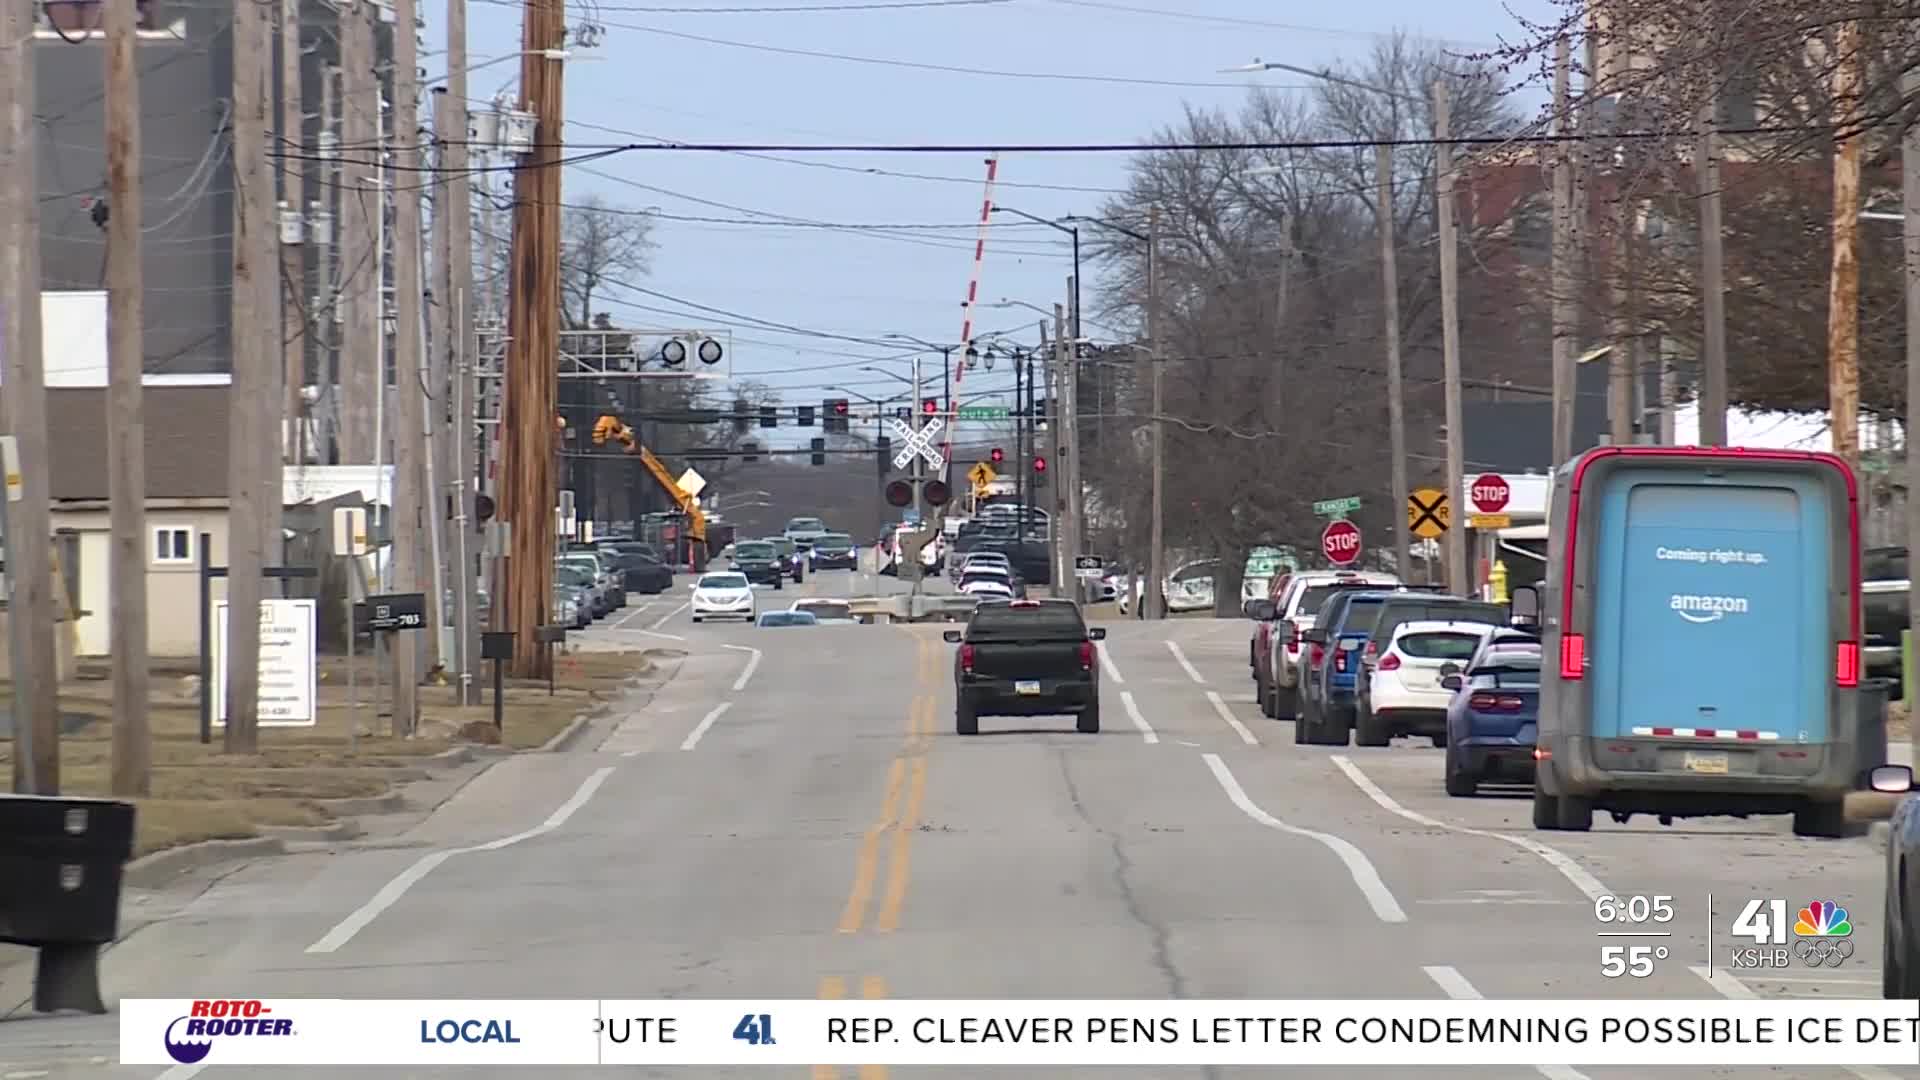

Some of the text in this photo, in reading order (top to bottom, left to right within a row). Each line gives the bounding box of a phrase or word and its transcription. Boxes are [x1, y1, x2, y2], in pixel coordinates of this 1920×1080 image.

[895, 419, 940, 466] CROSSING
[1473, 486, 1507, 501] STOP
[1407, 506, 1449, 519] R R
[1326, 532, 1358, 551] STOP
[1656, 546, 1768, 564] Coming right up.
[1671, 594, 1748, 612] amazon
[399, 614, 420, 625] 703
